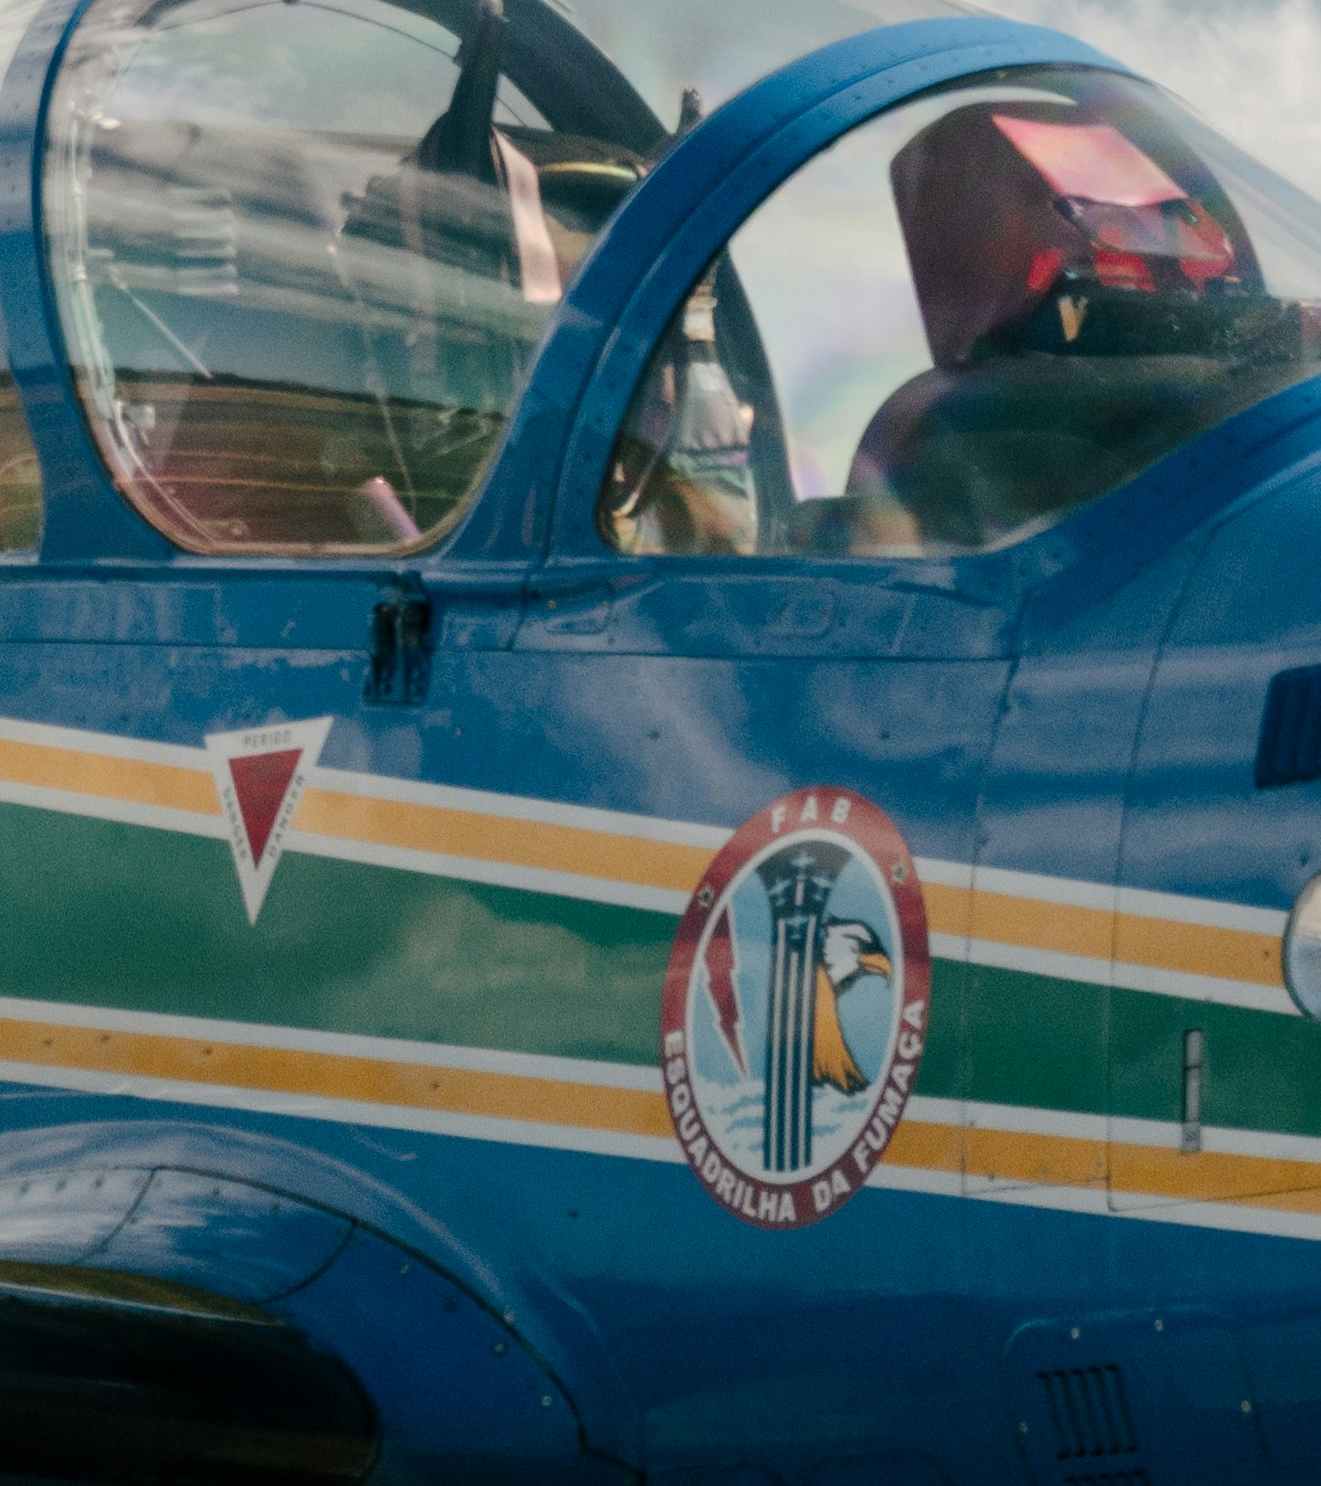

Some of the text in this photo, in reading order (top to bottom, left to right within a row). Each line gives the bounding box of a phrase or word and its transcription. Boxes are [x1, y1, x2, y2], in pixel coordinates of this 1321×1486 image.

[244, 730, 291, 749] PERIGO
[268, 774, 305, 859] DANGER
[770, 794, 852, 834] FAB
[664, 998, 925, 1223] ESQUADRILHA DA FUMAÇA
